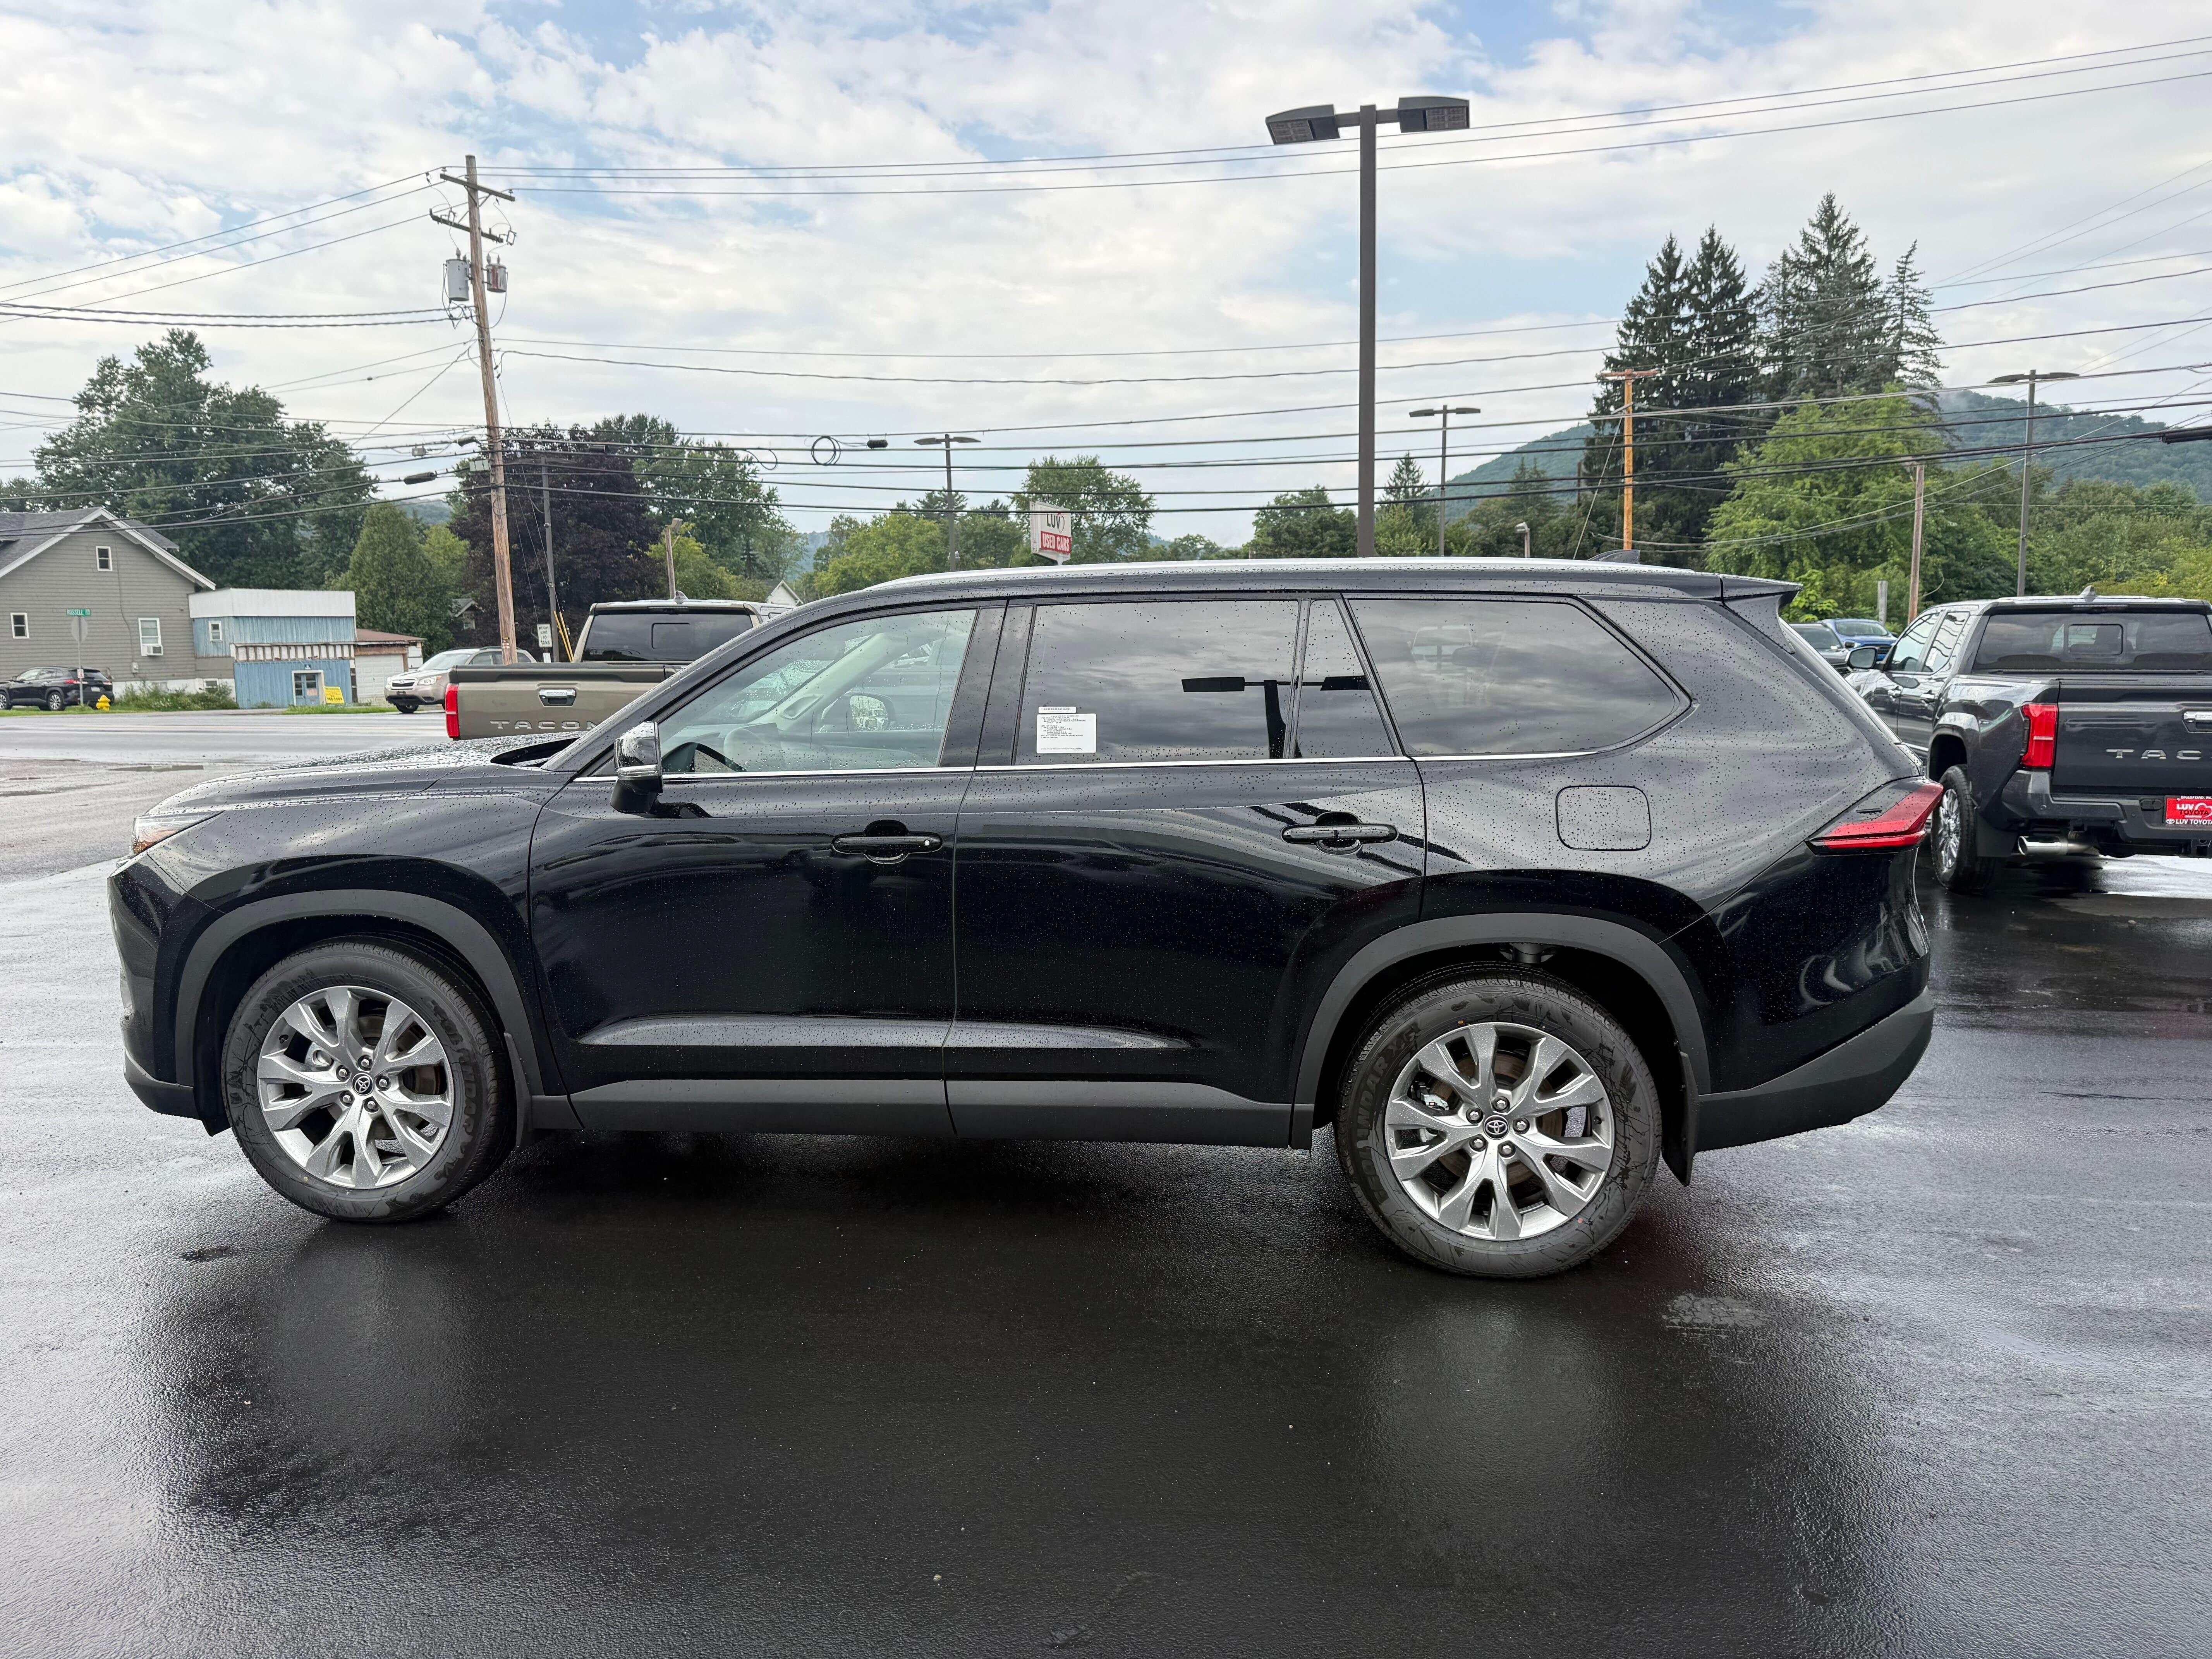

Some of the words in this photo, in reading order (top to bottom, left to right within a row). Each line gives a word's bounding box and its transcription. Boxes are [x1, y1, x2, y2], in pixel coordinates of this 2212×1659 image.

[1047, 514, 1060, 529] LUV
[1042, 533, 1056, 550] USED
[1057, 536, 1070, 552] CARS
[2106, 749, 2212, 760] TAC
